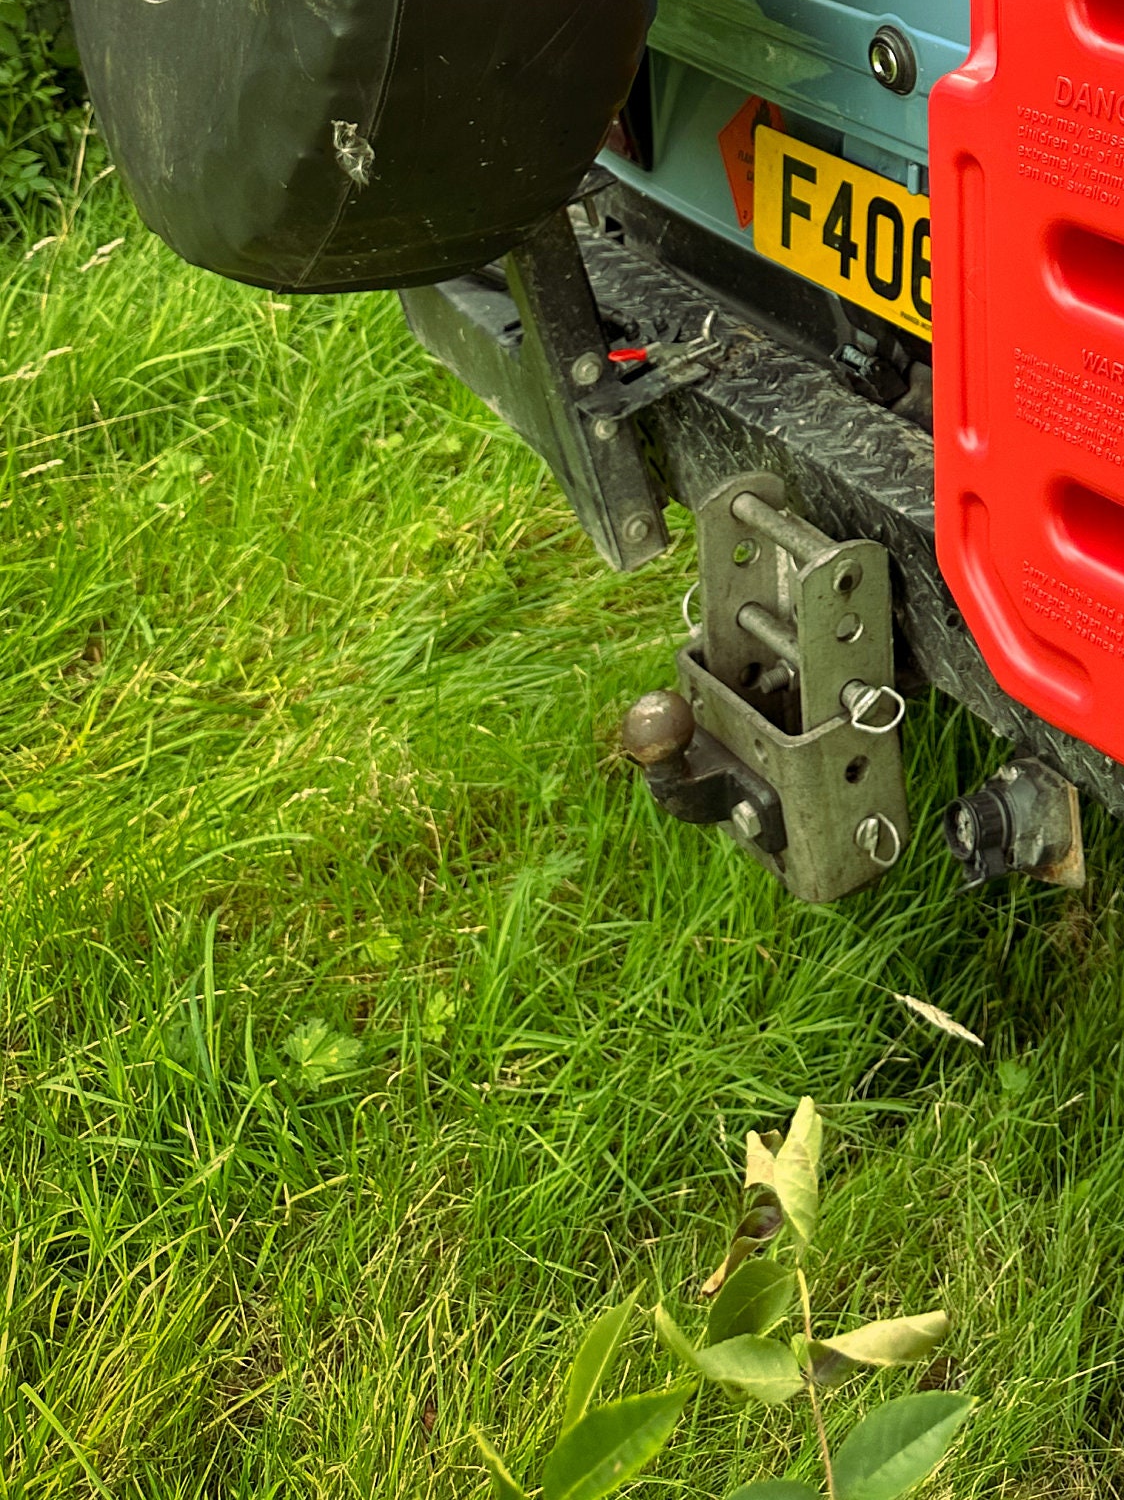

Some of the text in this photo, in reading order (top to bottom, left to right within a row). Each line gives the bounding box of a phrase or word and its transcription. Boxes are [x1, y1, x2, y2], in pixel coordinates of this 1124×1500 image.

[1017, 105, 1053, 125] vapor
[1056, 117, 1084, 139] may
[1018, 124, 1069, 151] children
[1072, 142, 1094, 159] out
[1097, 149, 1112, 164] of
[1018, 145, 1079, 178] extremely
[1018, 163, 1120, 207] can not swallow
